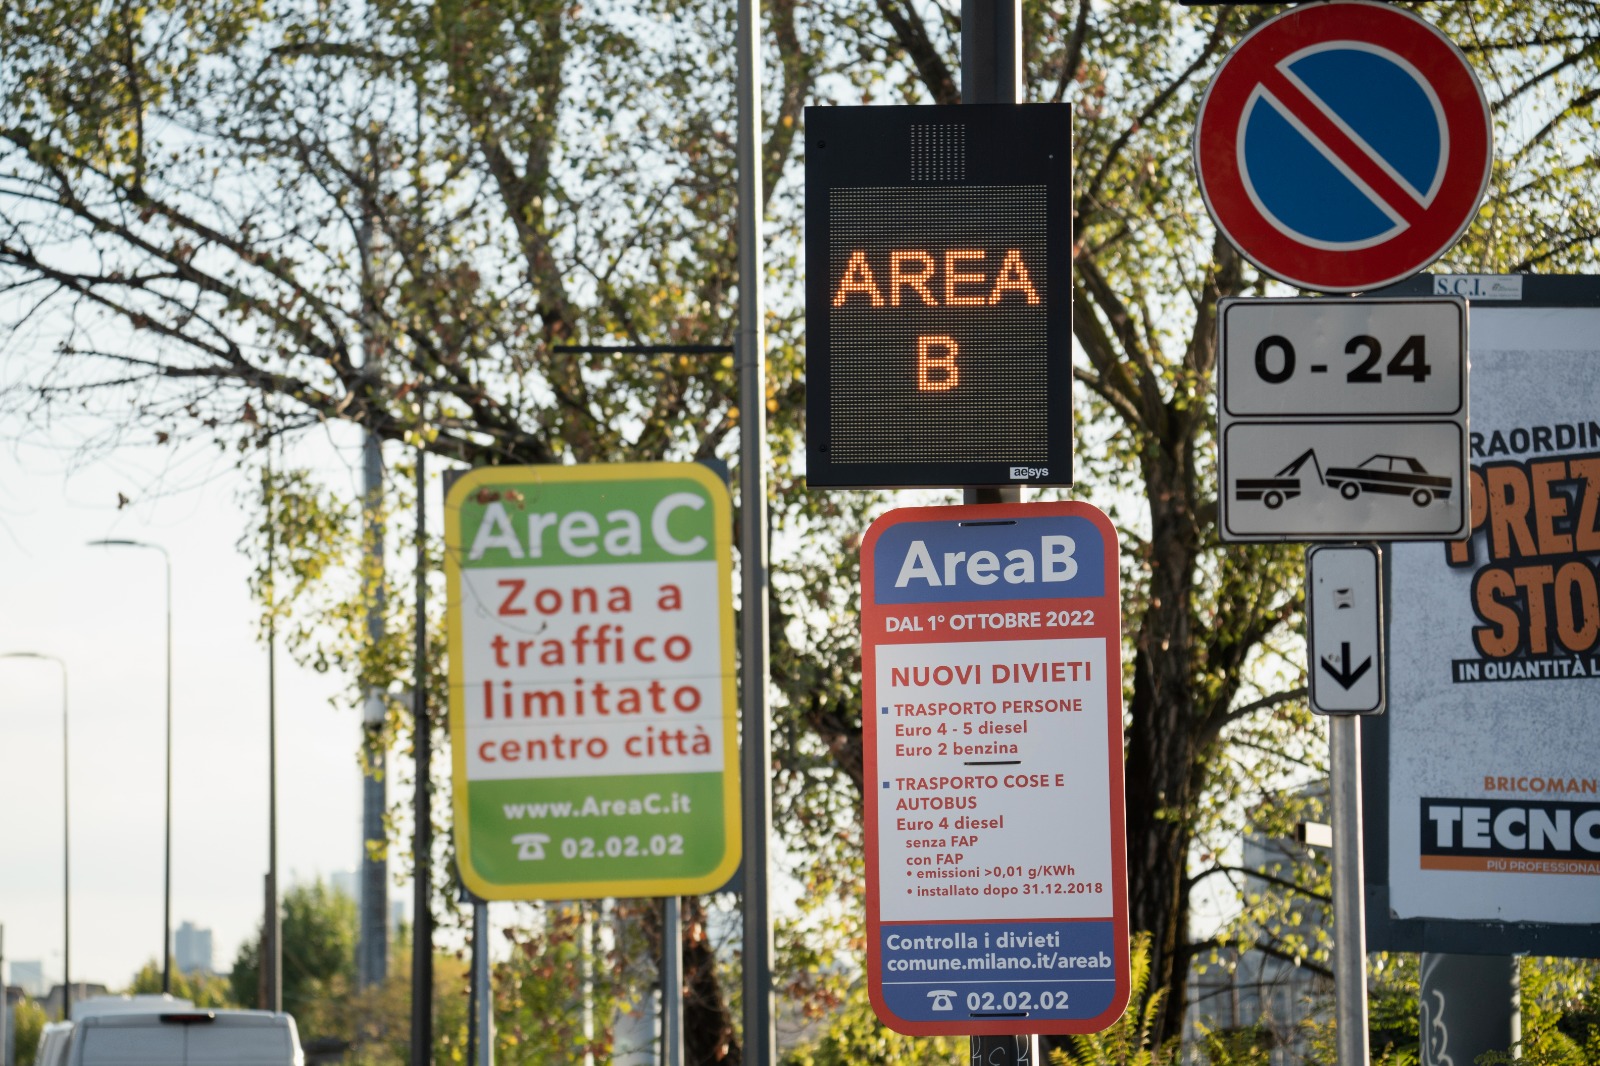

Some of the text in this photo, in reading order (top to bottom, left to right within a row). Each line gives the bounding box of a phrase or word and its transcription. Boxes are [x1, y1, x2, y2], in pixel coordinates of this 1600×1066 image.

[833, 250, 1041, 307] AREA
[1437, 277, 1486, 296] S.C.I.
[919, 336, 959, 391] B
[1255, 335, 1296, 384] 0
[1344, 334, 1431, 383] 24
[1014, 467, 1049, 479] aesys
[497, 578, 682, 616] Zona a
[885, 609, 1095, 632] DAL 1° OTTOBRE 2022
[491, 623, 692, 668] traffico
[891, 661, 1091, 687] NUOVI DIVIETI
[1459, 663, 1480, 680] IN
[1484, 654, 1586, 679] QUANTITÀ
[482, 677, 702, 720] limitato
[894, 698, 1083, 718] TRASPORTO PERSONE
[895, 723, 932, 737] Euro
[937, 722, 948, 735] 4
[962, 721, 973, 735] 5
[978, 720, 1028, 735] diesel
[478, 725, 712, 763] centro città
[895, 741, 1018, 757] Euro 2 benzina
[896, 773, 1065, 791] TRASPORTO COSE E
[1484, 776, 1597, 794] BRICOMAN
[503, 793, 691, 820] www.AreaC.it
[896, 796, 977, 811] AUTOBUS
[896, 815, 1004, 831] Euro 4 diesel
[561, 834, 684, 860] 02.02.02
[905, 836, 978, 848] senza FAP
[906, 854, 964, 866] con FAP
[916, 864, 1076, 880] emissioni >0,01 g/KWh
[917, 882, 1103, 898] installato dopo 31.12.2018
[886, 931, 1060, 950] Controlla i divieti
[887, 951, 1112, 971] comune.milano.it/areab
[966, 991, 1069, 1011] 02.02.02
